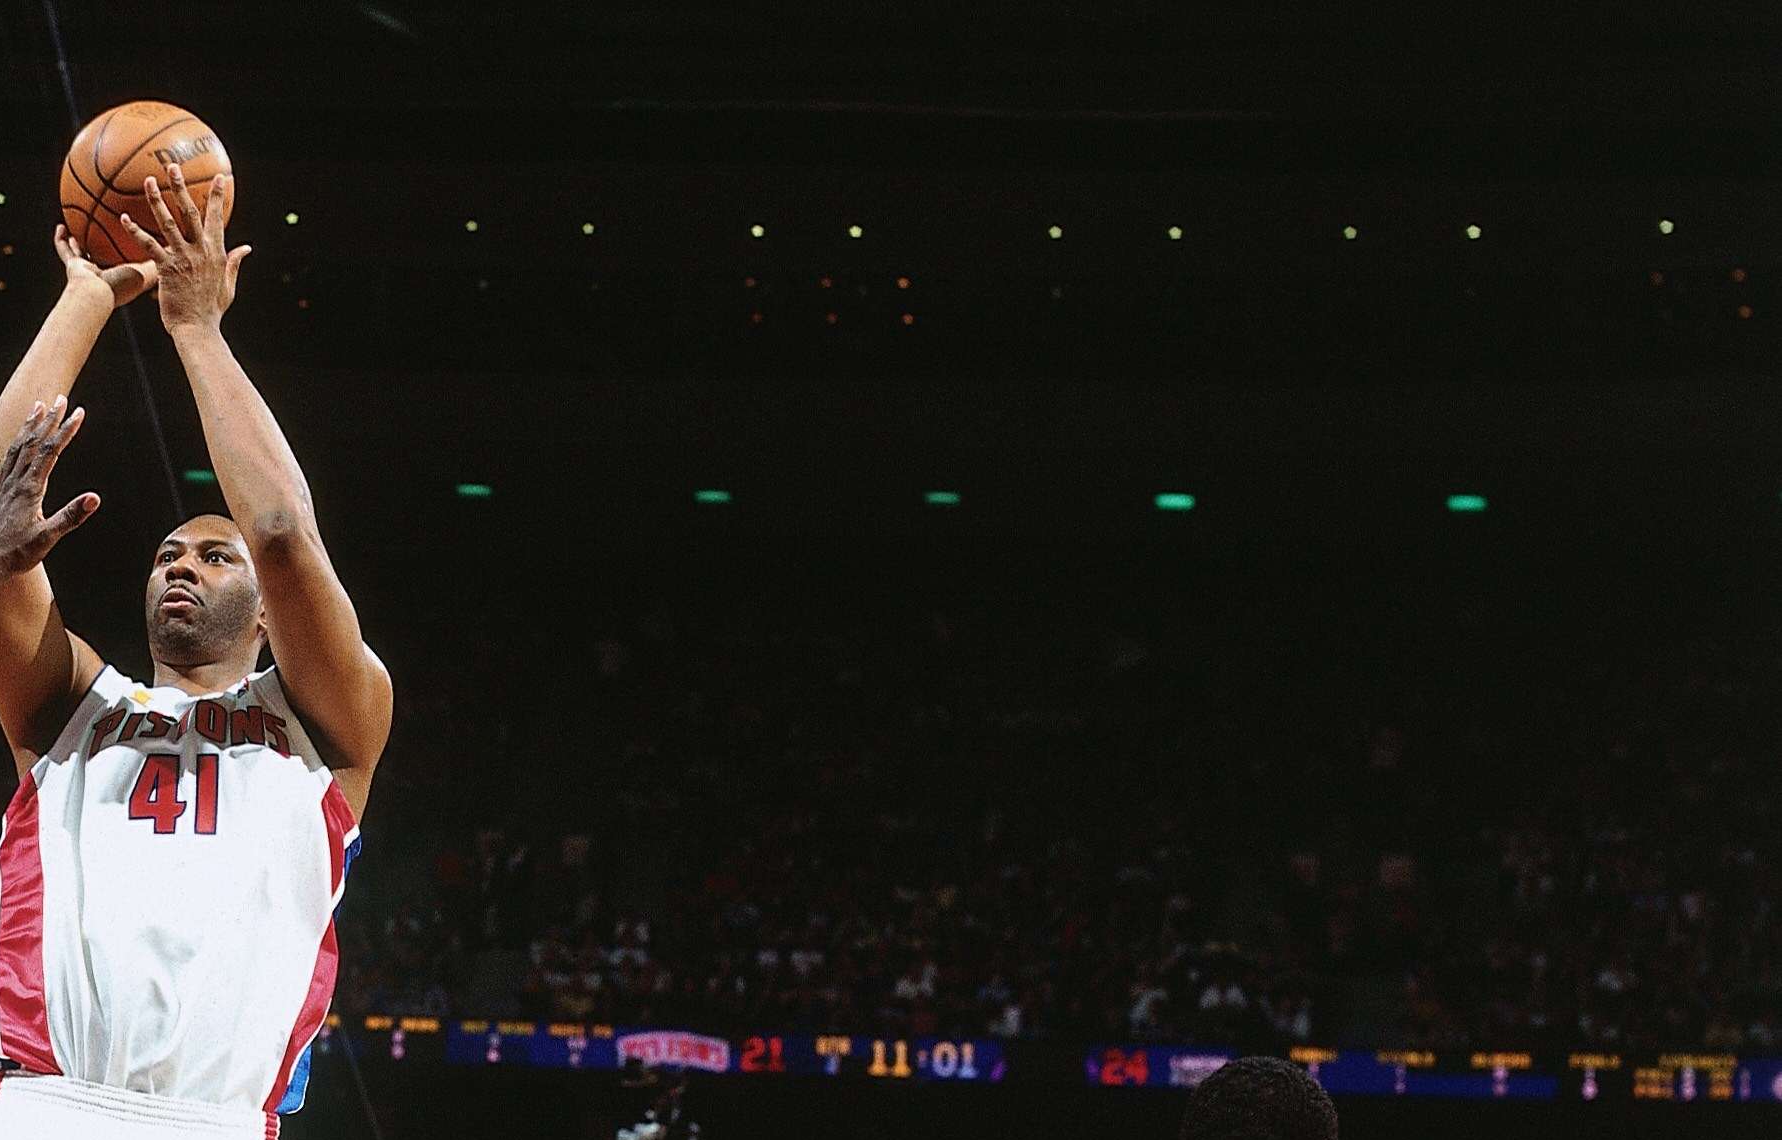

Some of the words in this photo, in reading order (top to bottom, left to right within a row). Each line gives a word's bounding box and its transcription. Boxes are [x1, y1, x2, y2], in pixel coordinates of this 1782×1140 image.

[87, 698, 291, 761] PISTONS
[128, 753, 219, 835] 41
[740, 1036, 786, 1074] 21
[867, 1039, 978, 1079] 11:01
